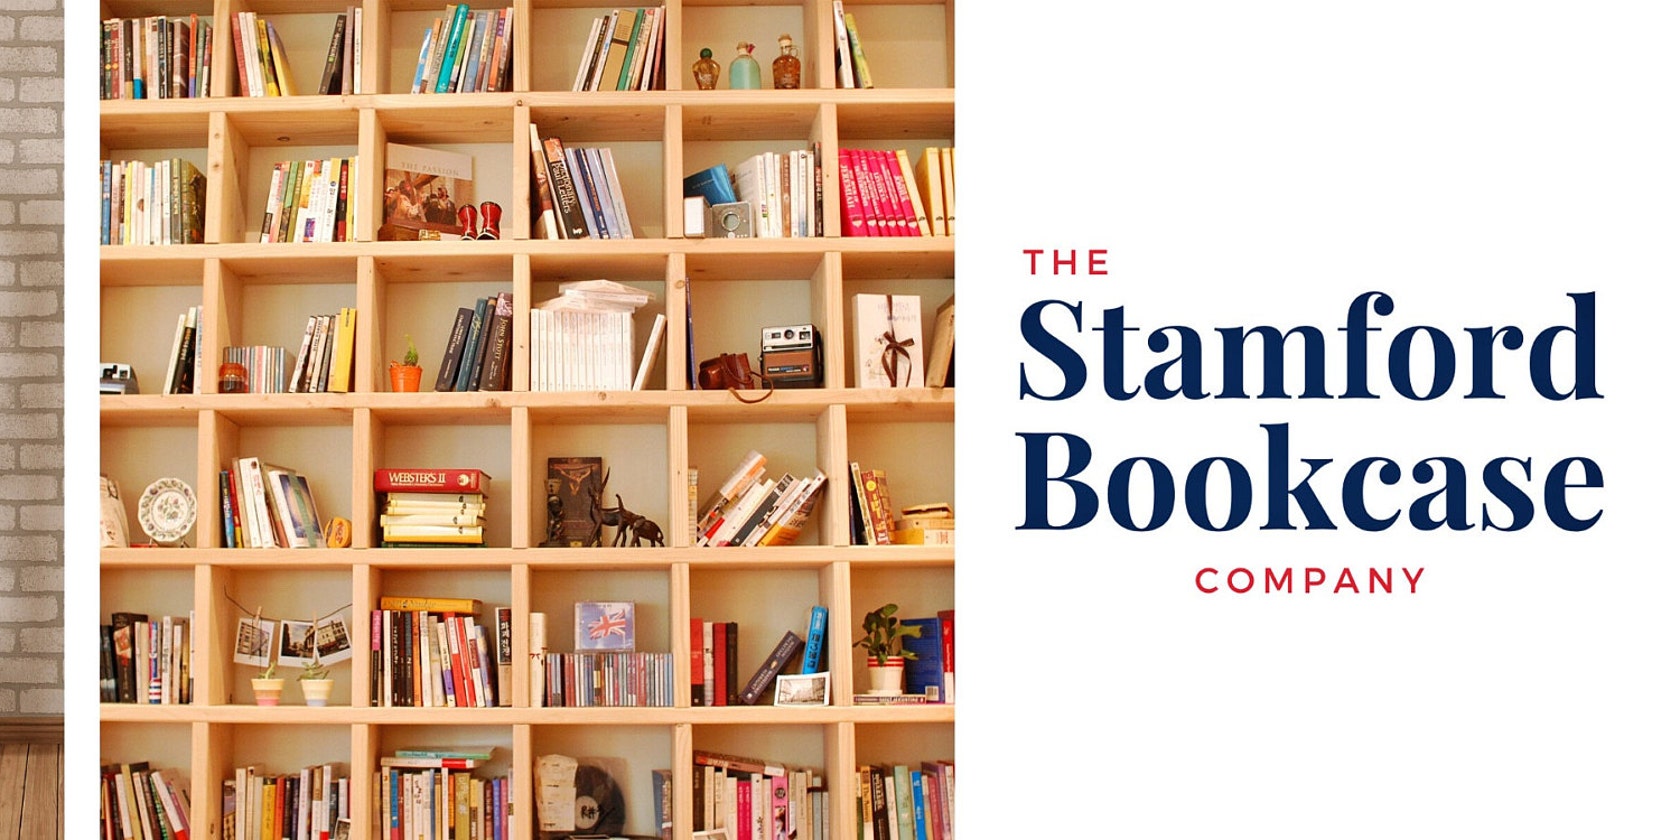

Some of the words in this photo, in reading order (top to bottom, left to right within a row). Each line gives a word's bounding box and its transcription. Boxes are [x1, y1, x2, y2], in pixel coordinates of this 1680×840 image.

[401, 160, 421, 171] THE
[423, 164, 460, 177] PASSION
[551, 163, 563, 181] Paul
[558, 160, 577, 206] Dictionary
[840, 165, 855, 208] JEREMIAH
[555, 184, 571, 214] Letters
[499, 318, 509, 337] JOHN
[495, 338, 505, 360] STOTT
[388, 471, 437, 484] WEBSTER'S
